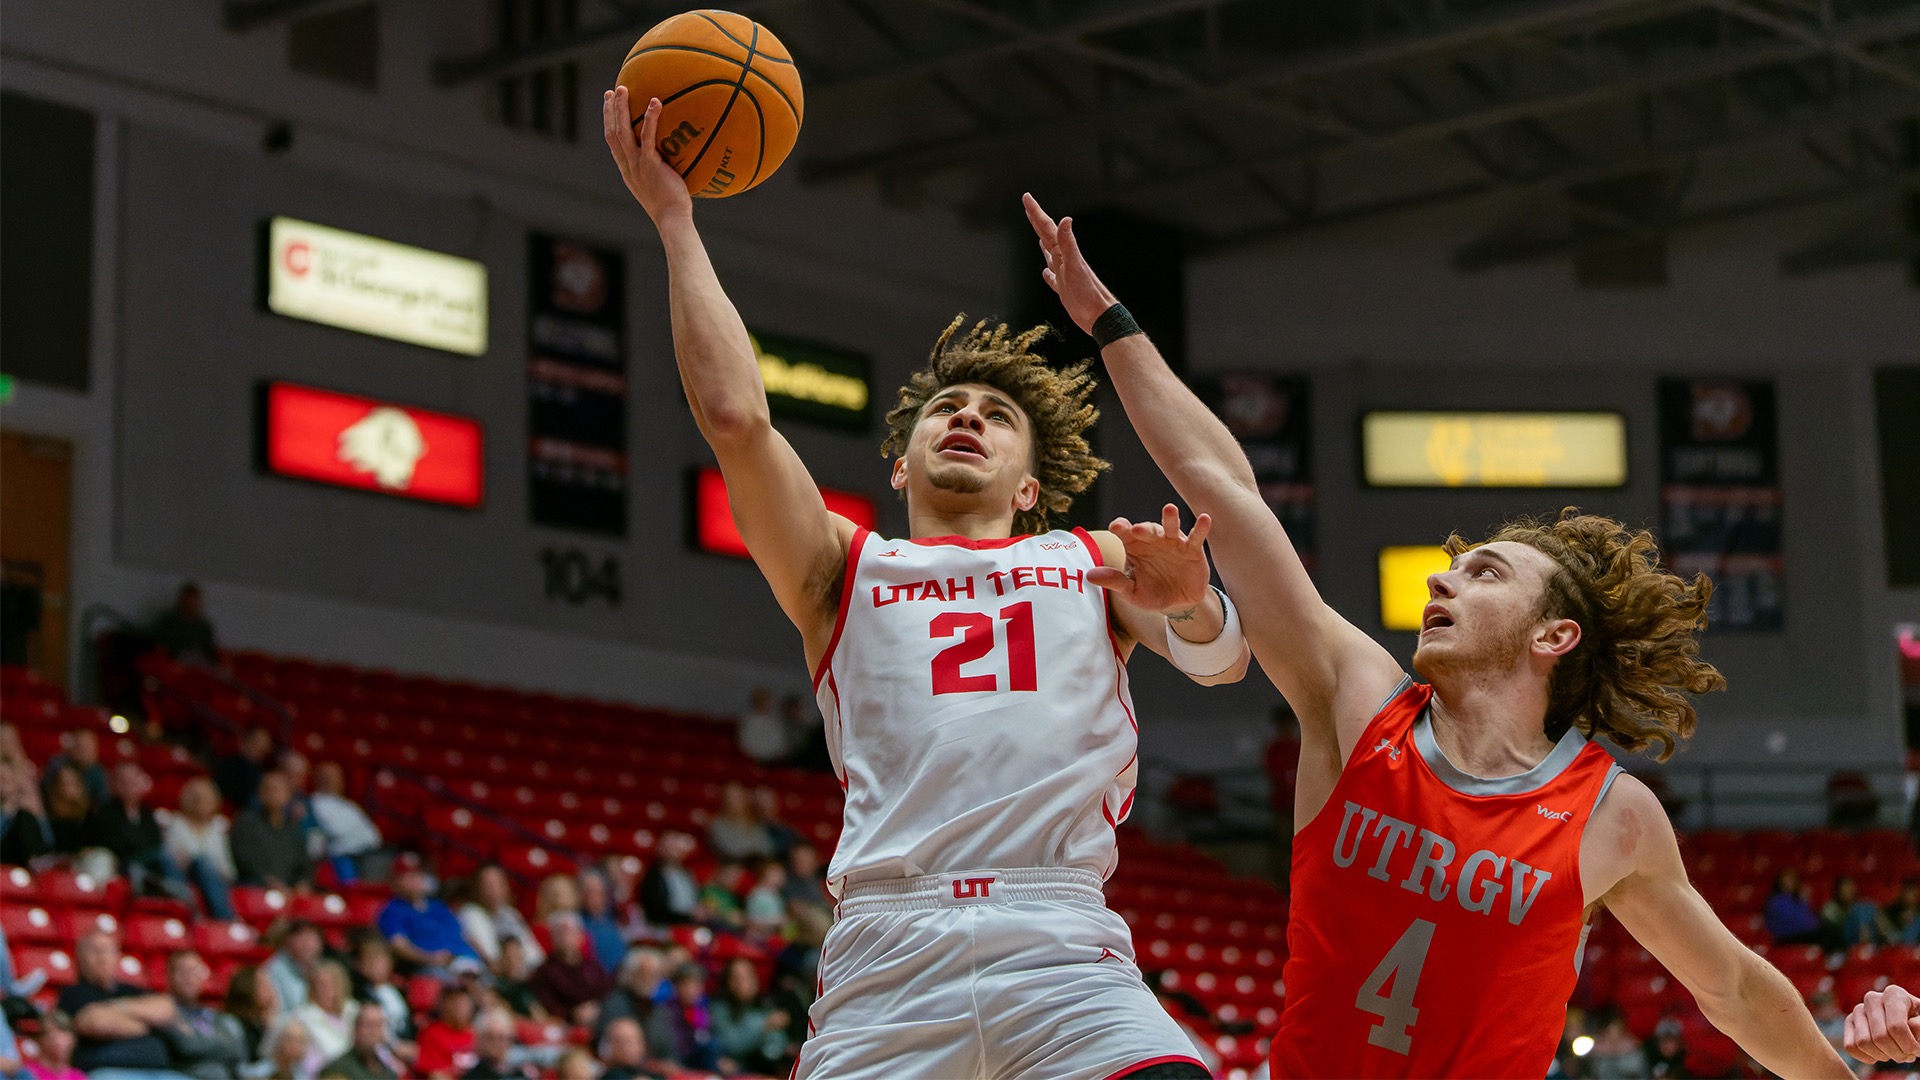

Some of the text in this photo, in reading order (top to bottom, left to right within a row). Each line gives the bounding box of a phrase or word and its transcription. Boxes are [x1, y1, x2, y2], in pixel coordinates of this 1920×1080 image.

[537, 546, 622, 608] 104
[871, 566, 1084, 608] UTAH TECH
[929, 601, 1038, 696] 21
[1537, 804, 1573, 823] WAC
[952, 877, 995, 899] UT
[1332, 800, 1552, 926] UTRGV
[1355, 917, 1437, 1056] 4
